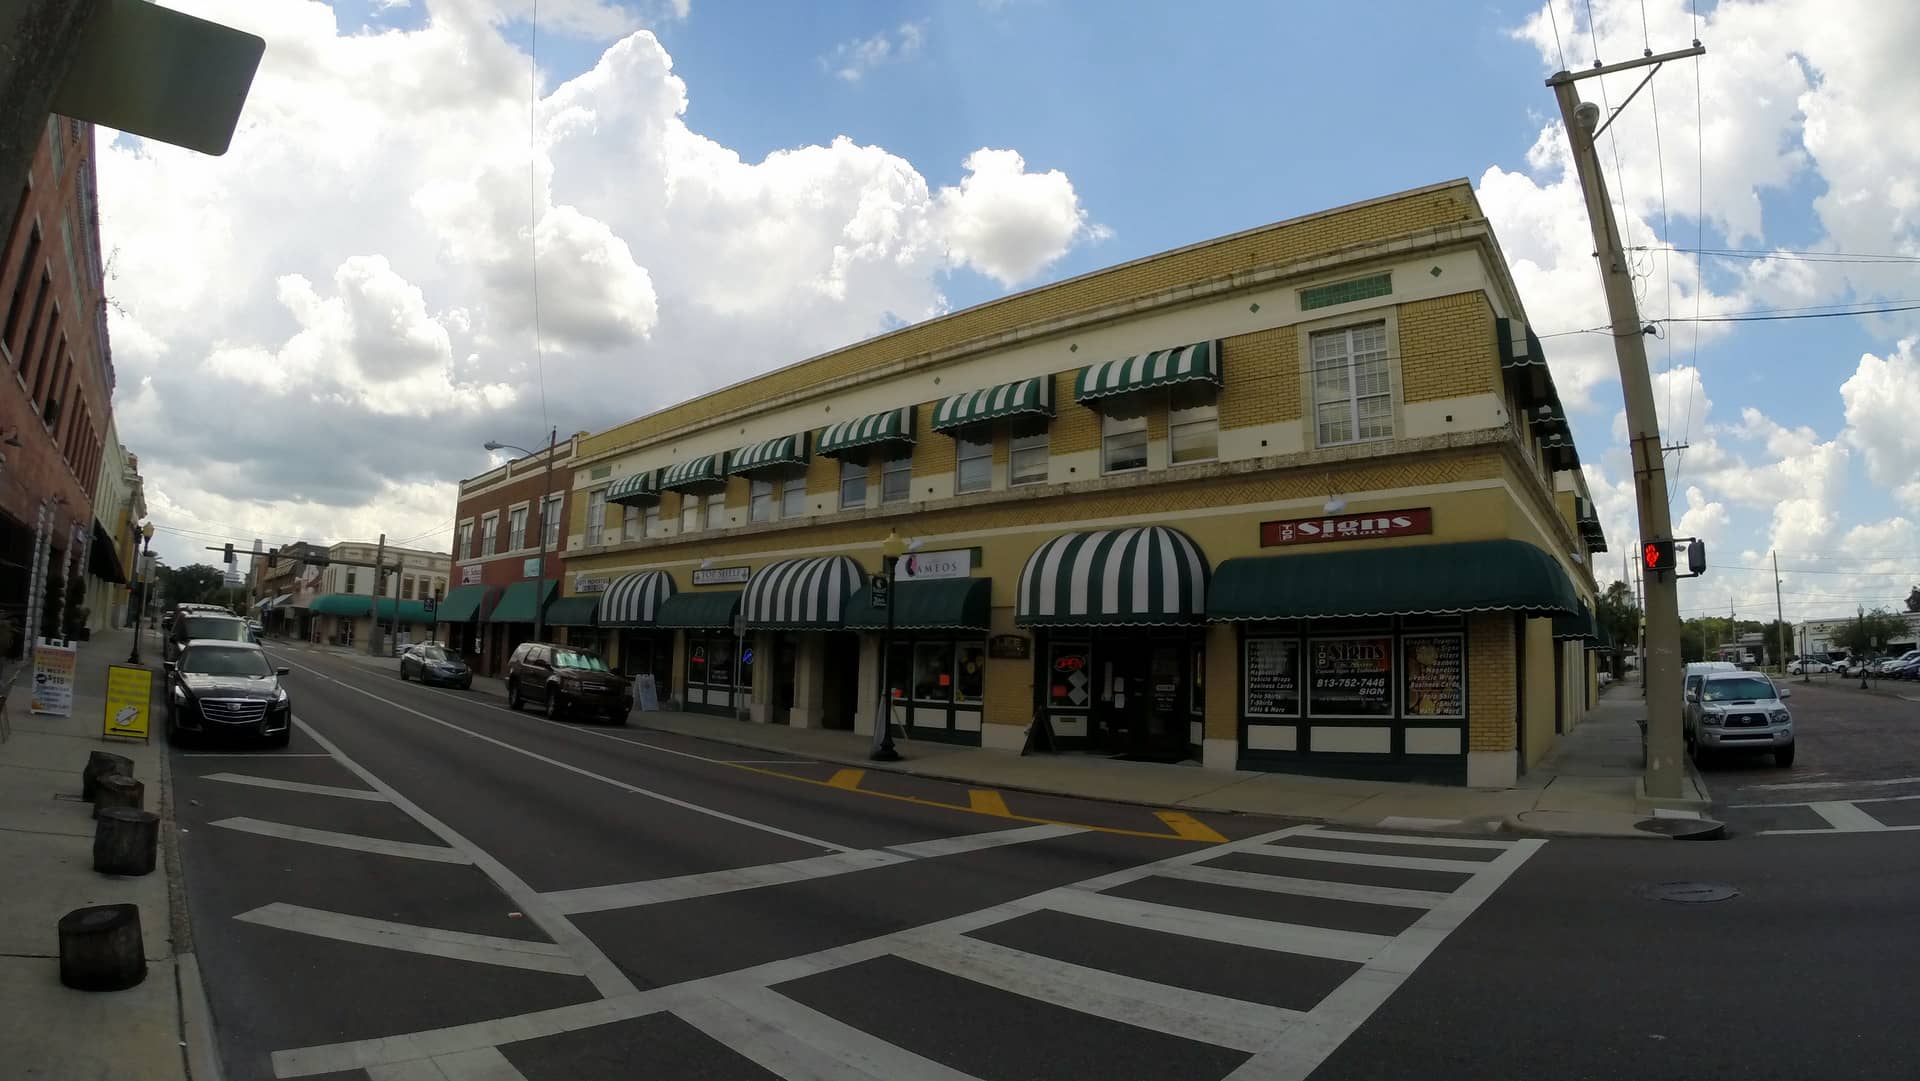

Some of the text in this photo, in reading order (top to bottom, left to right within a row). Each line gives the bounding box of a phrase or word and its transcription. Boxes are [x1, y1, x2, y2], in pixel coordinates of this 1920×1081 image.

[1281, 523, 1293, 541] TOP
[1297, 516, 1413, 536] Signs
[1341, 529, 1387, 538] More
[1328, 642, 1386, 661] Signs
[1316, 678, 1385, 688] 813-752-7446
[1359, 688, 1385, 696] SIGN
